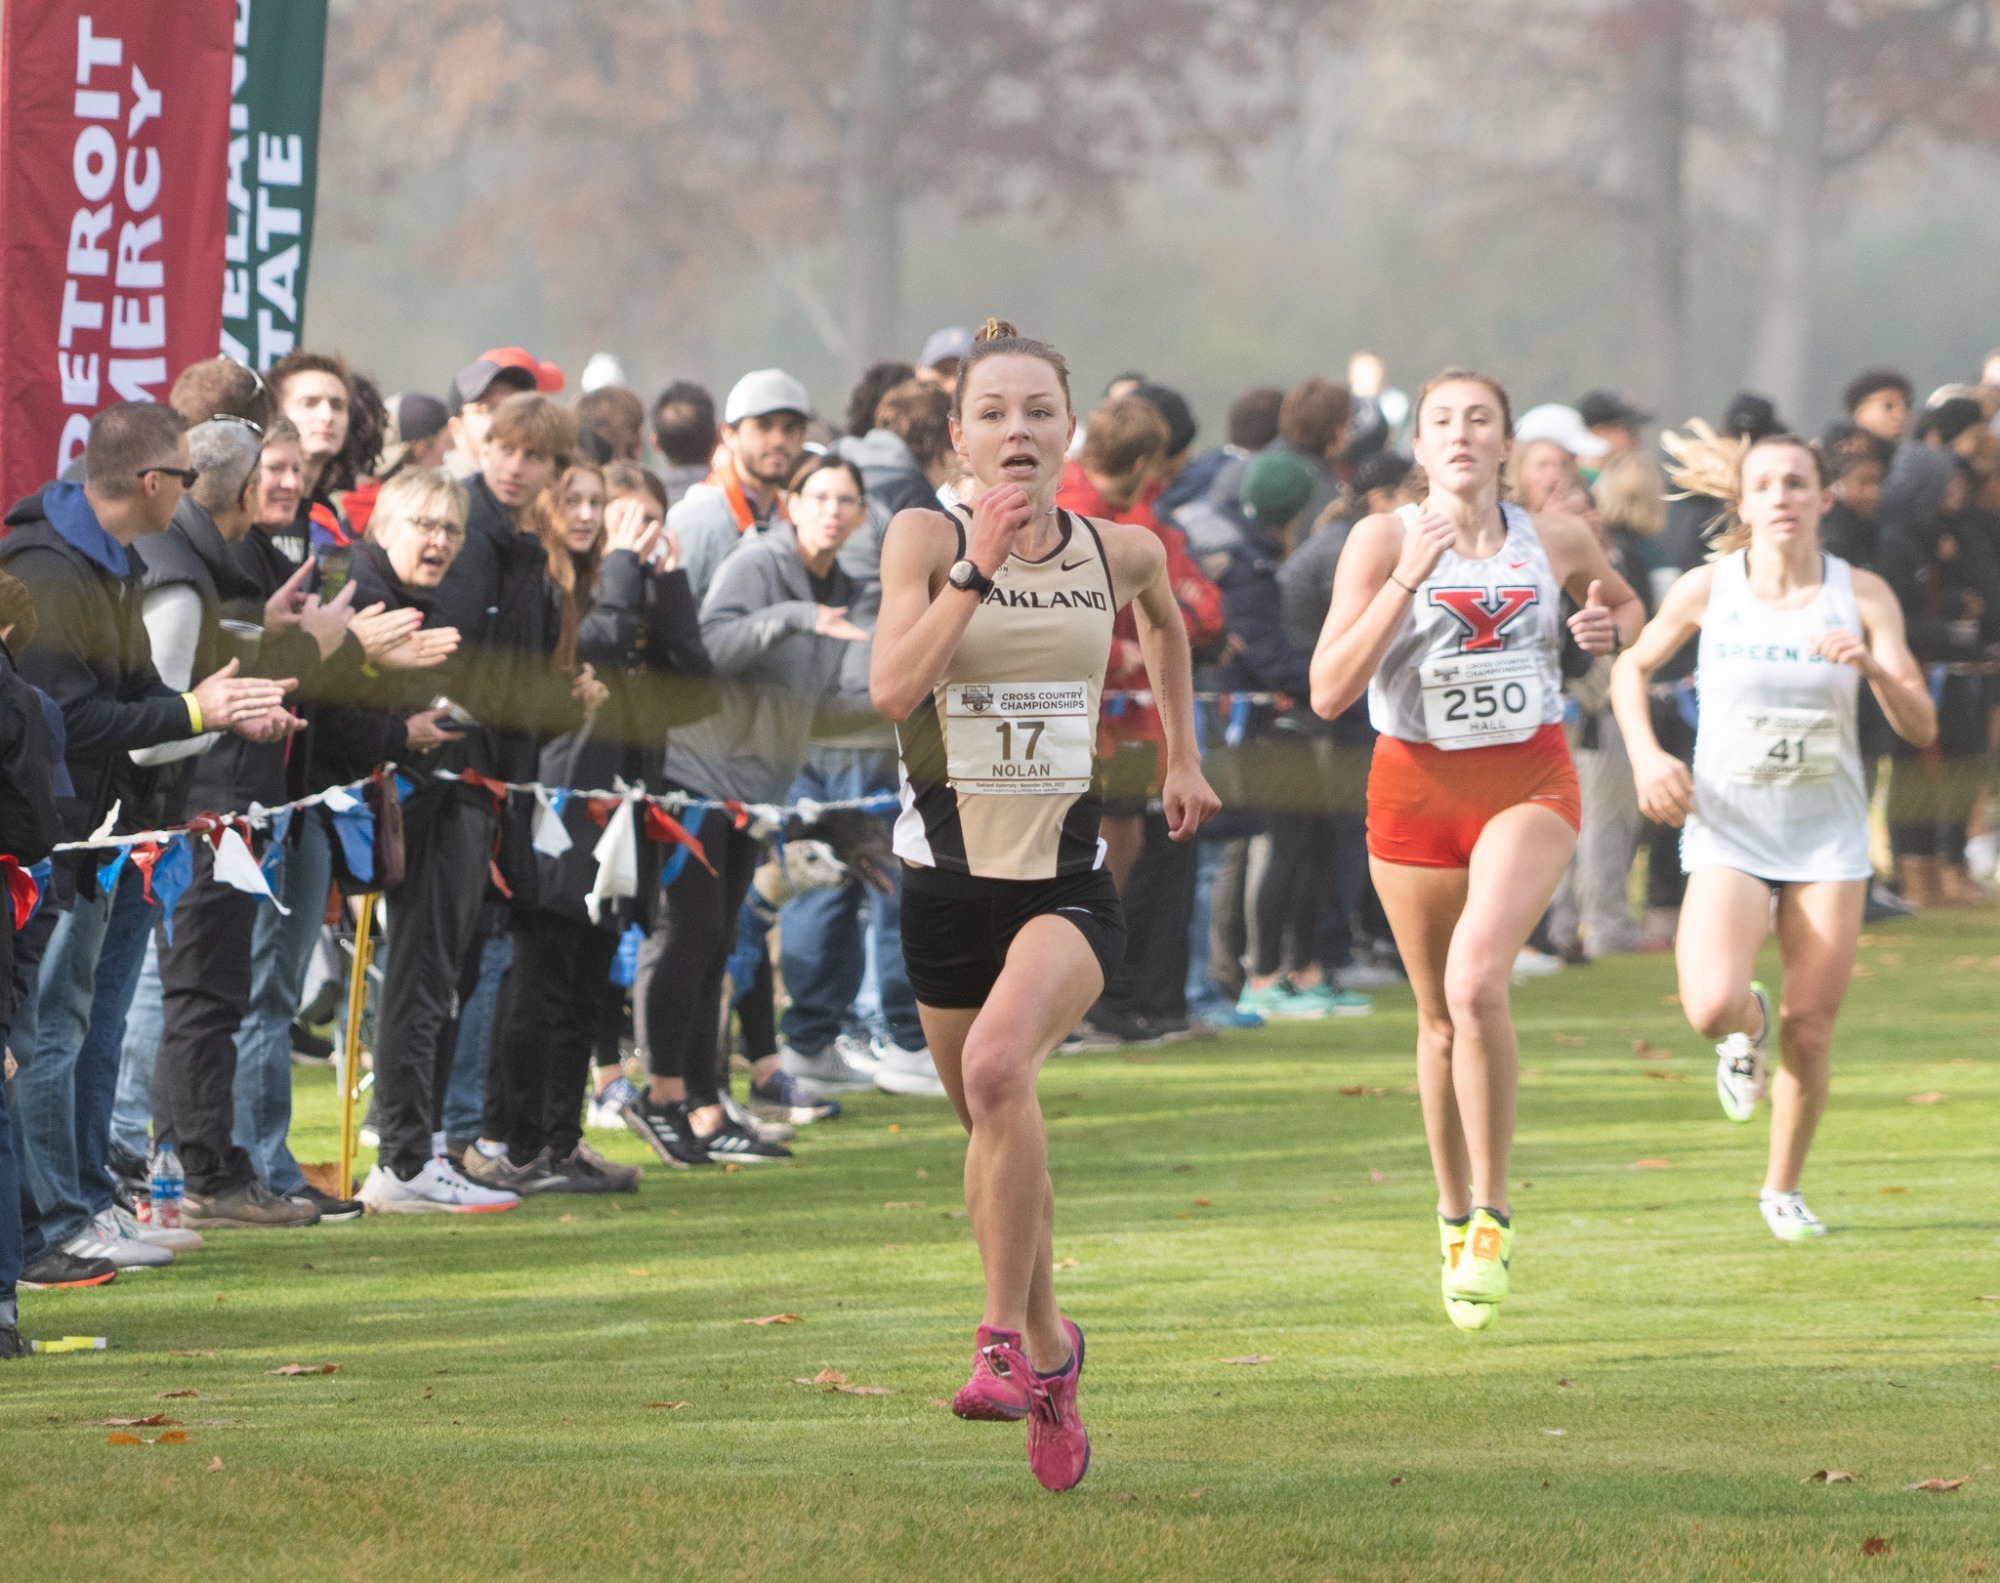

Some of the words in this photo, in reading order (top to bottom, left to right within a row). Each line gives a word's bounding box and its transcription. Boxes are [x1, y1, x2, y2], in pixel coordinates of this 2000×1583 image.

[979, 587, 1107, 611] AKLAND
[1002, 692, 1036, 701] CROSS
[1038, 691, 1083, 700] COUNTRY
[1443, 682, 1526, 721] 250
[1000, 700, 1085, 711] CHAMPIONSHIPS
[1469, 719, 1507, 732] HALL
[996, 721, 1045, 761] 17
[1768, 738, 1805, 763] 41
[992, 764, 1051, 777] NOLAN
